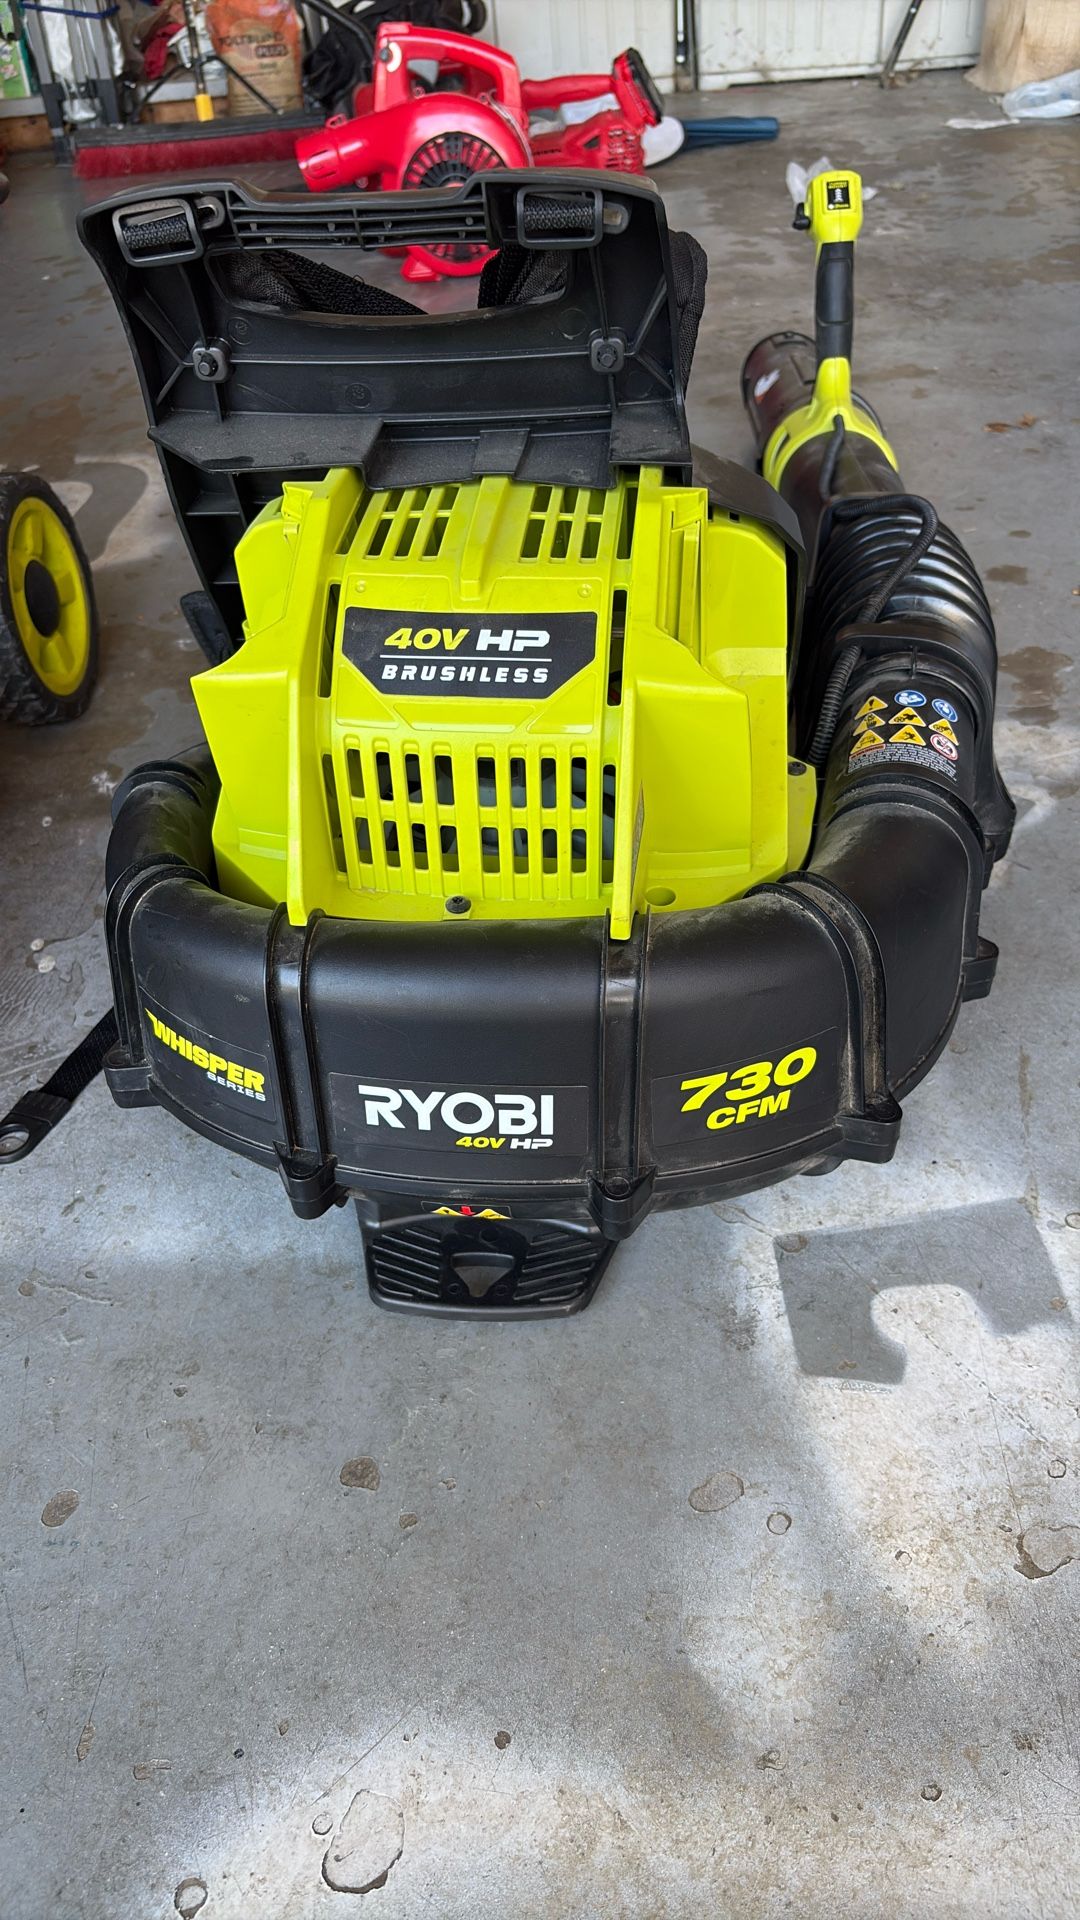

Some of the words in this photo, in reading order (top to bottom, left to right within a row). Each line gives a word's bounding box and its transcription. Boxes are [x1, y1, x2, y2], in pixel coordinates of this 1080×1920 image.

[384, 628, 470, 650] 40V
[476, 629, 550, 652] HP
[381, 664, 549, 684] BRUSHLESS
[144, 1007, 265, 1093] WHISPER
[206, 1071, 266, 1101] SERIES
[680, 1046, 817, 1112] 730
[358, 1084, 554, 1135] RYOBI
[706, 1089, 791, 1130] CFM
[456, 1136, 506, 1149] 40V
[510, 1138, 554, 1150] HP
